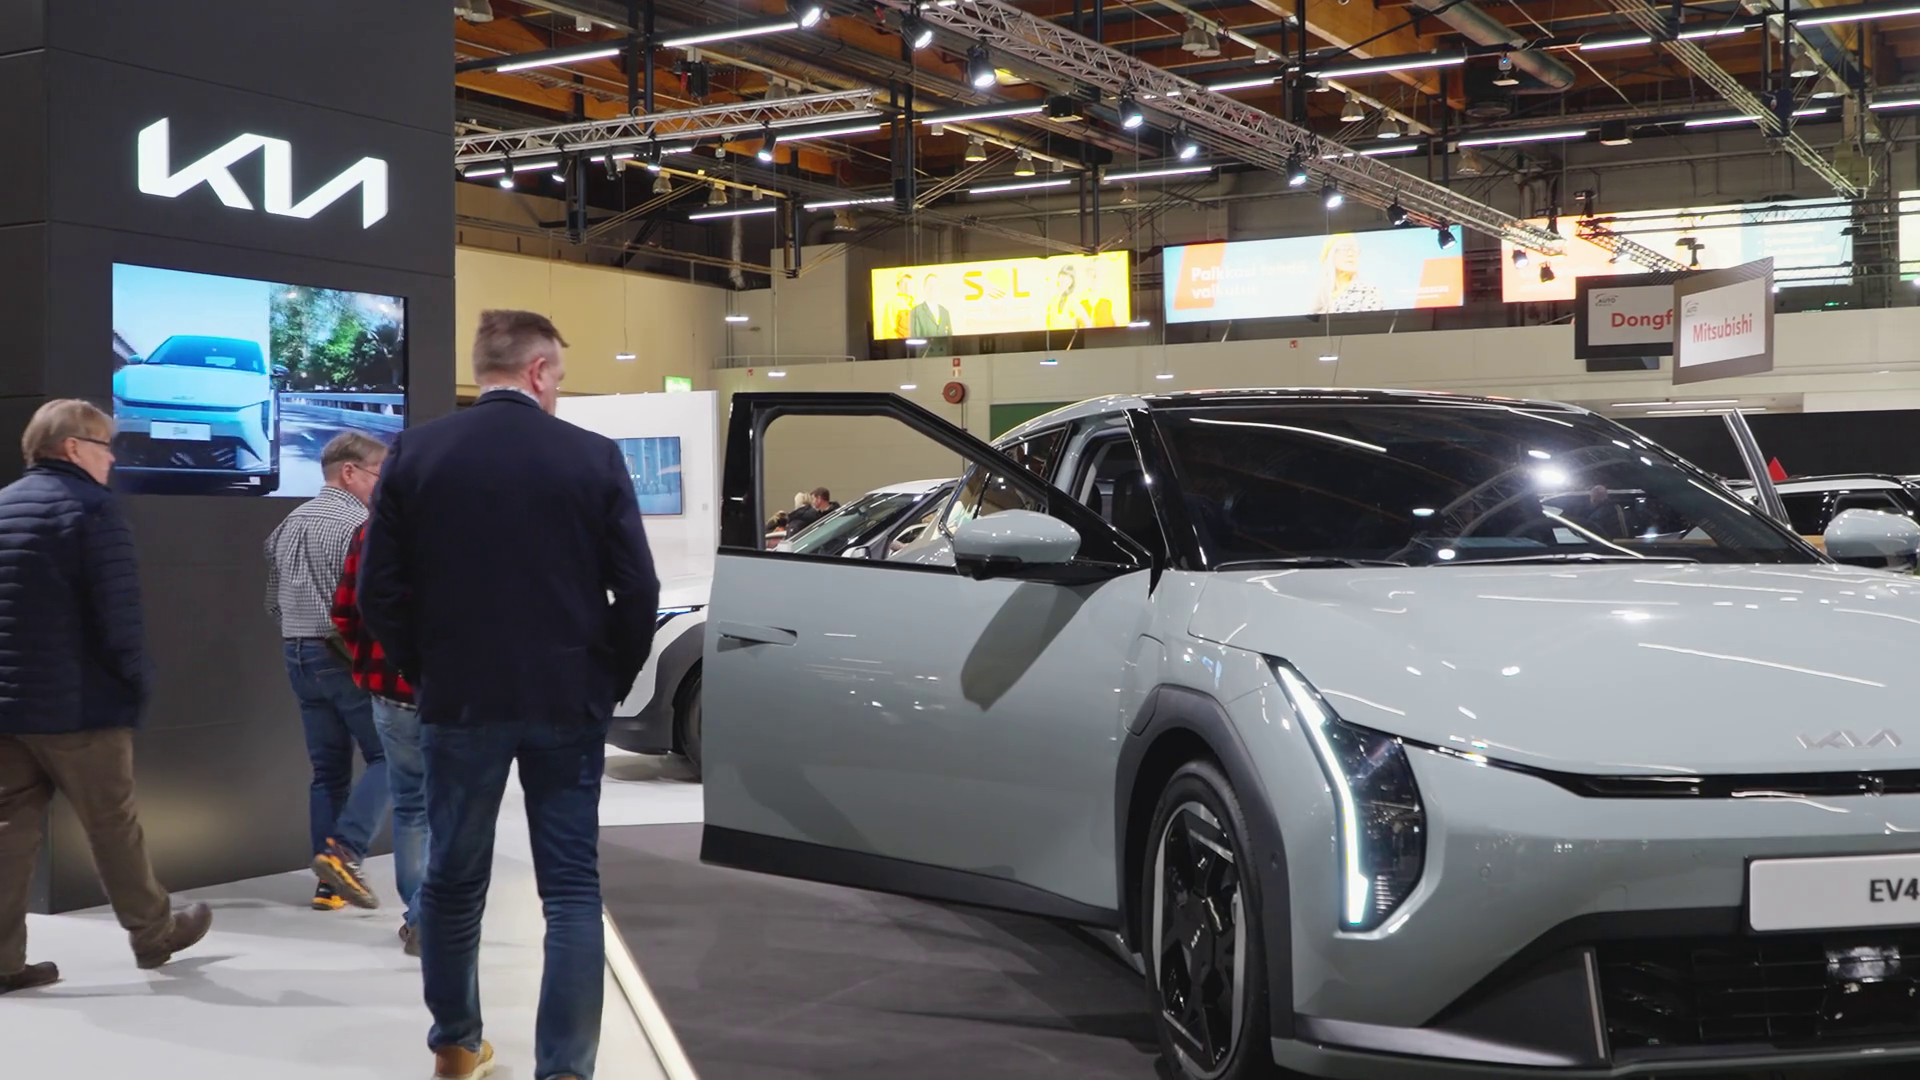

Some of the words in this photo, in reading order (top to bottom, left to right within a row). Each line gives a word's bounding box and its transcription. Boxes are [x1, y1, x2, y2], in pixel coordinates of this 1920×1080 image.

[137, 117, 389, 230] KIA
[1692, 312, 1753, 344] Mitsubishi
[1795, 727, 1903, 750] KIA
[1869, 877, 1920, 903] EV4
